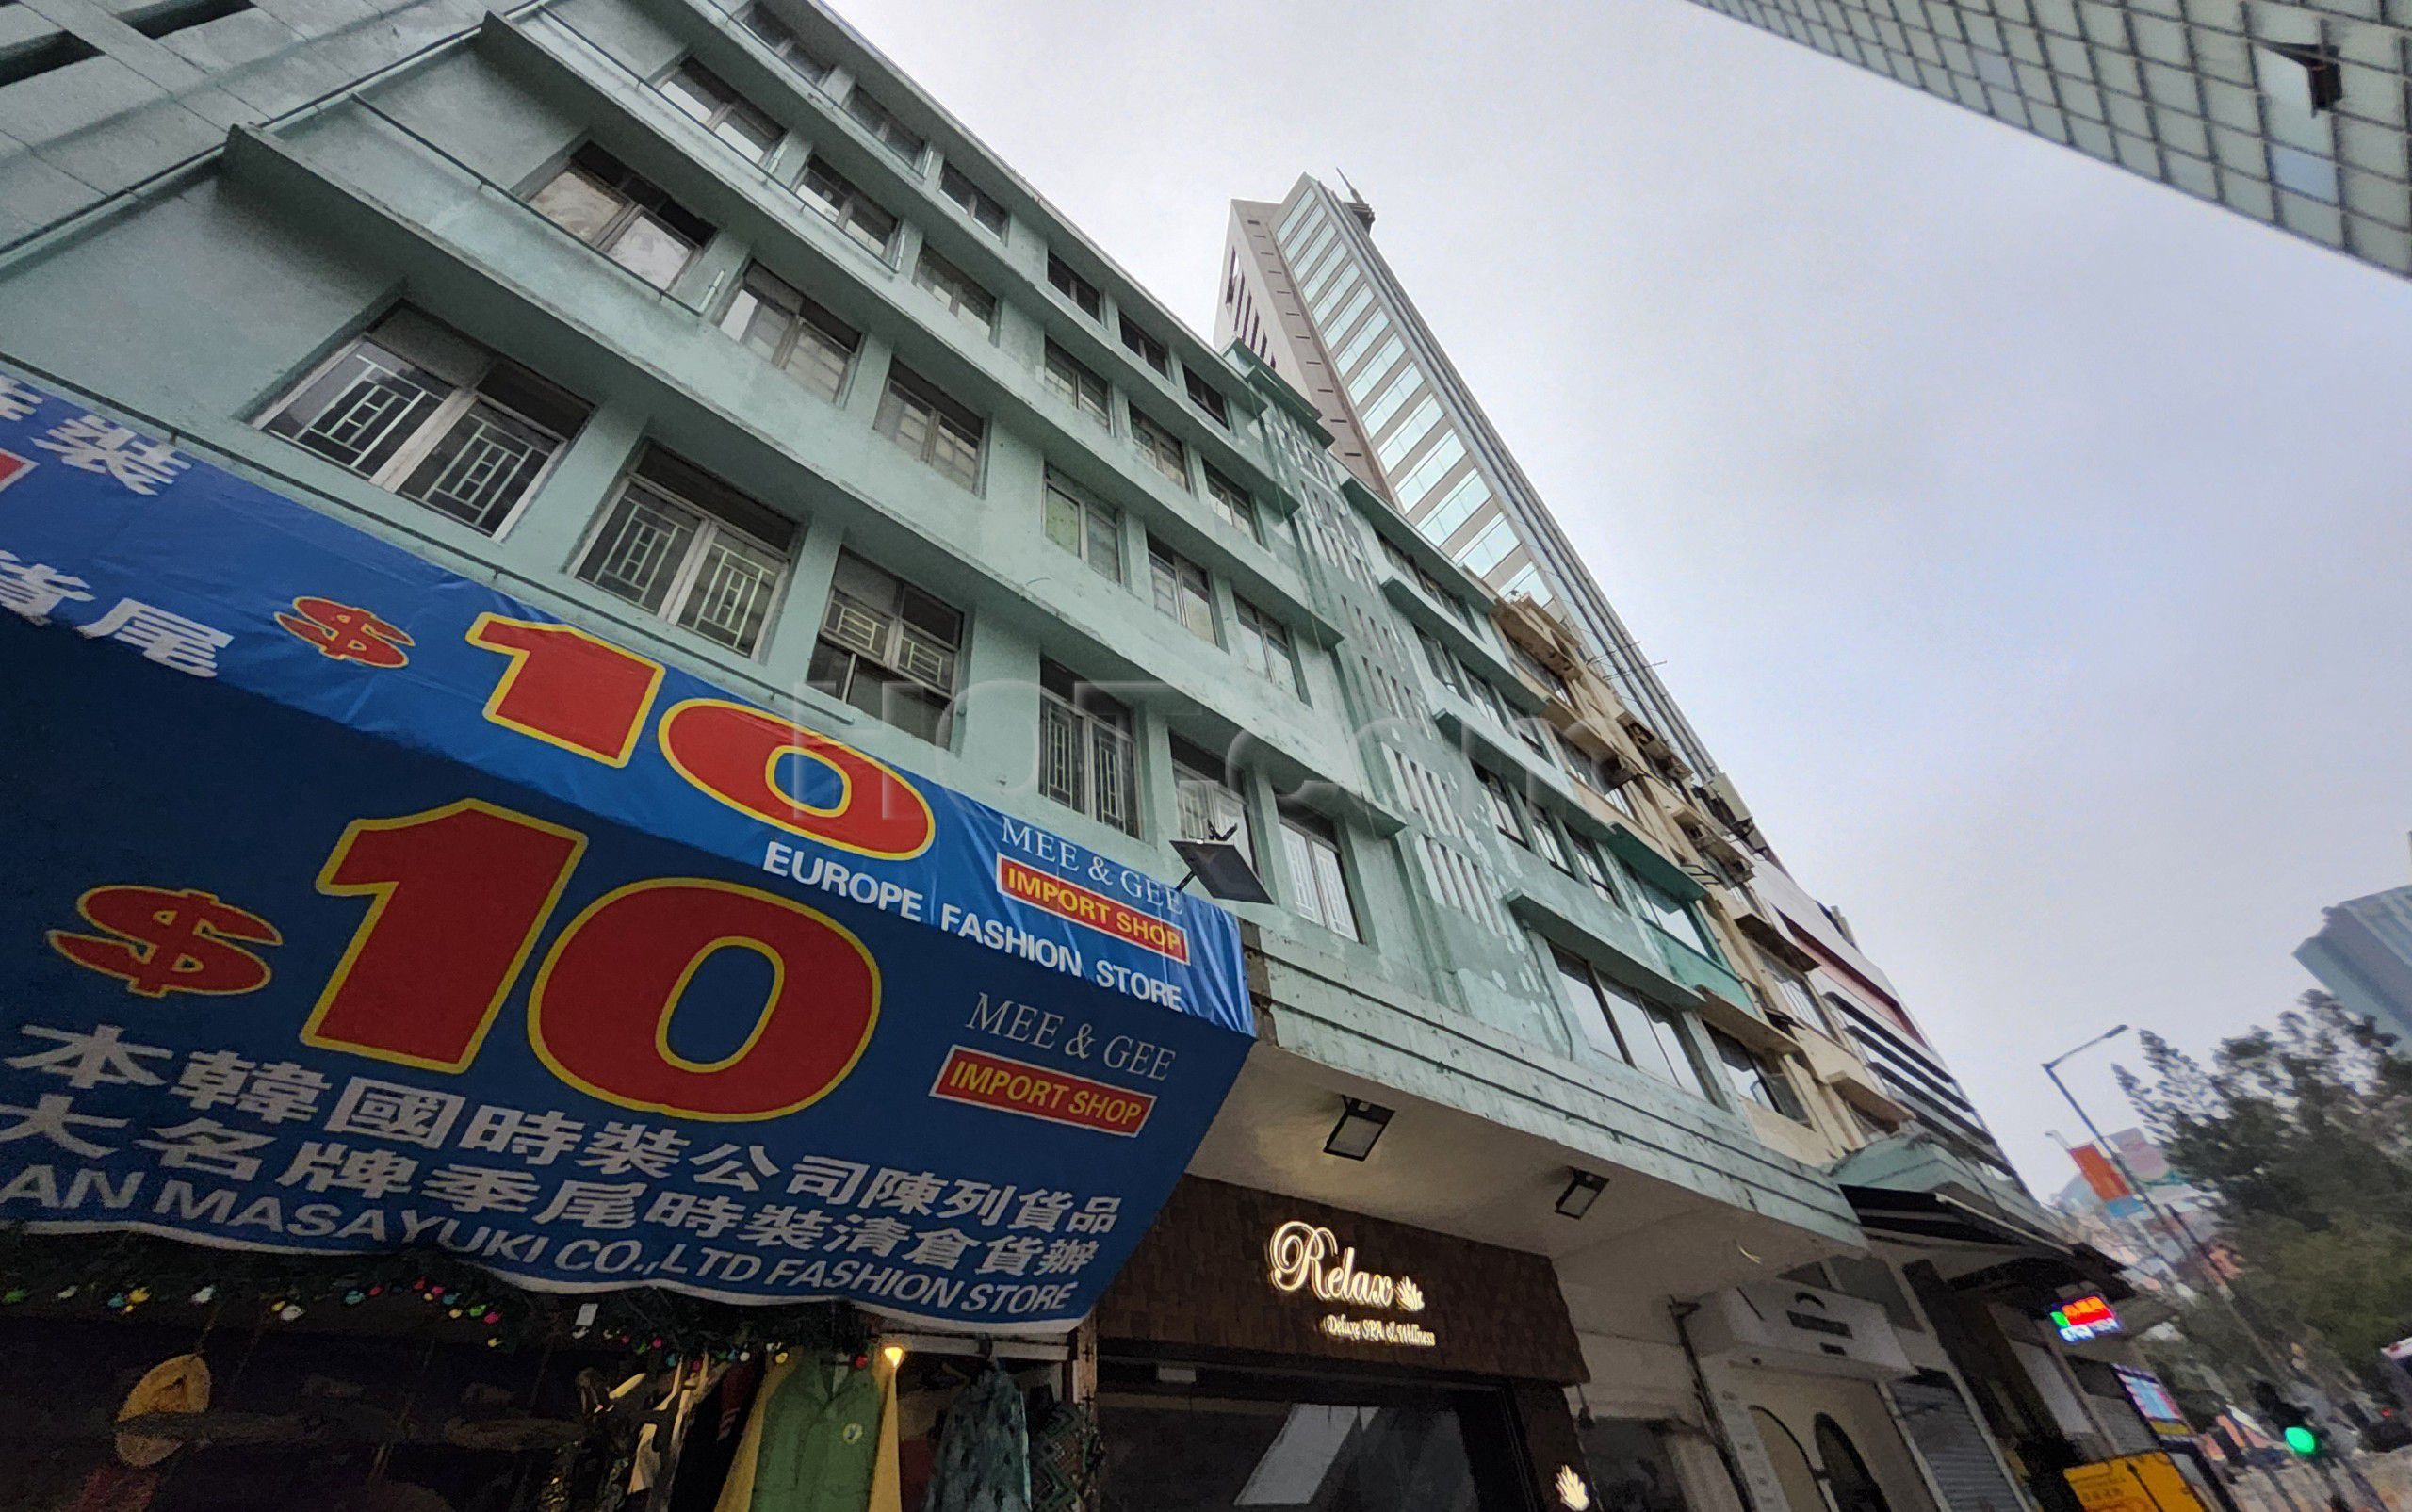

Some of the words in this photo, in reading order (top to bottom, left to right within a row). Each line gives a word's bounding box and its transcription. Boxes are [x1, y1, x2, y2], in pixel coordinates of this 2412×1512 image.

[1001, 817, 1080, 872] MEE
[1088, 856, 1114, 885] &
[1119, 868, 1183, 916] GEE
[1007, 867, 1112, 927] IMPORT
[1116, 909, 1182, 952] SHOP
[763, 840, 924, 923] EUROPE
[941, 903, 1083, 977] FASHION
[1096, 960, 1184, 1013] STORE
[965, 992, 1064, 1049] MEE
[1065, 1023, 1097, 1059] &
[1103, 1035, 1177, 1081] GEE
[3, 1024, 1122, 1233] 本韓國時裝公司陳列貨品
[949, 1060, 1070, 1110] IMPORT
[1067, 1089, 1143, 1126] SHOP
[153, 1179, 549, 1263] MASAYUKI
[764, 1258, 966, 1309] FASHION
[960, 1281, 1079, 1314] STORE
[1269, 1221, 1393, 1308] Relax
